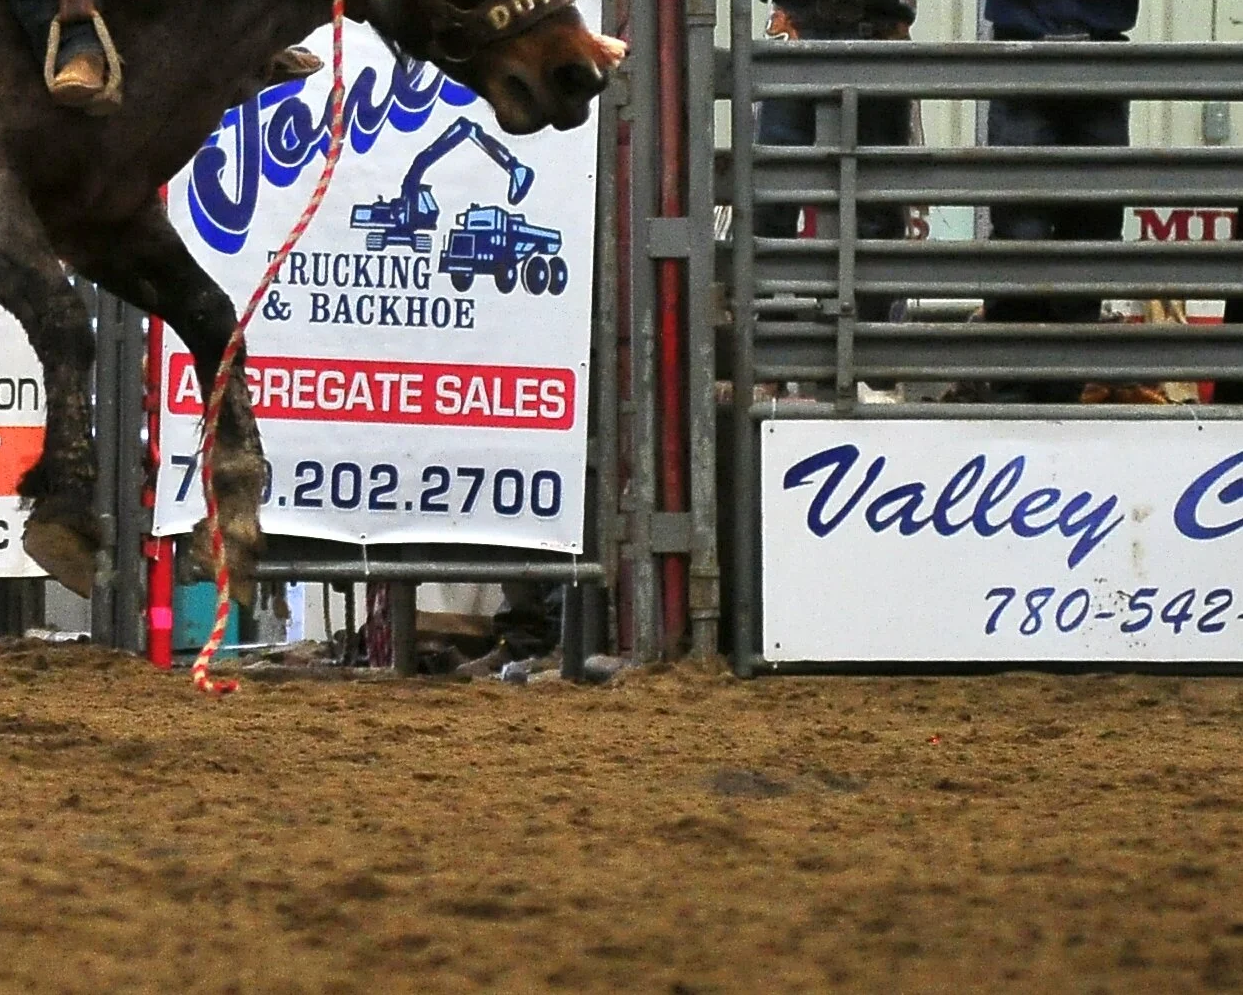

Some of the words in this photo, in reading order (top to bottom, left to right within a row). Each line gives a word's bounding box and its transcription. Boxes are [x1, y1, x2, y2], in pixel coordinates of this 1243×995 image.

[188, 56, 478, 254] Jone
[268, 251, 432, 290] TRUCKING
[263, 290, 292, 321] &
[309, 292, 475, 329] BACKHOE
[175, 365, 423, 413] AGREGATE
[435, 375, 566, 419] SALES
[171, 455, 562, 517] 7.202.2700
[783, 444, 1125, 569] Valley
